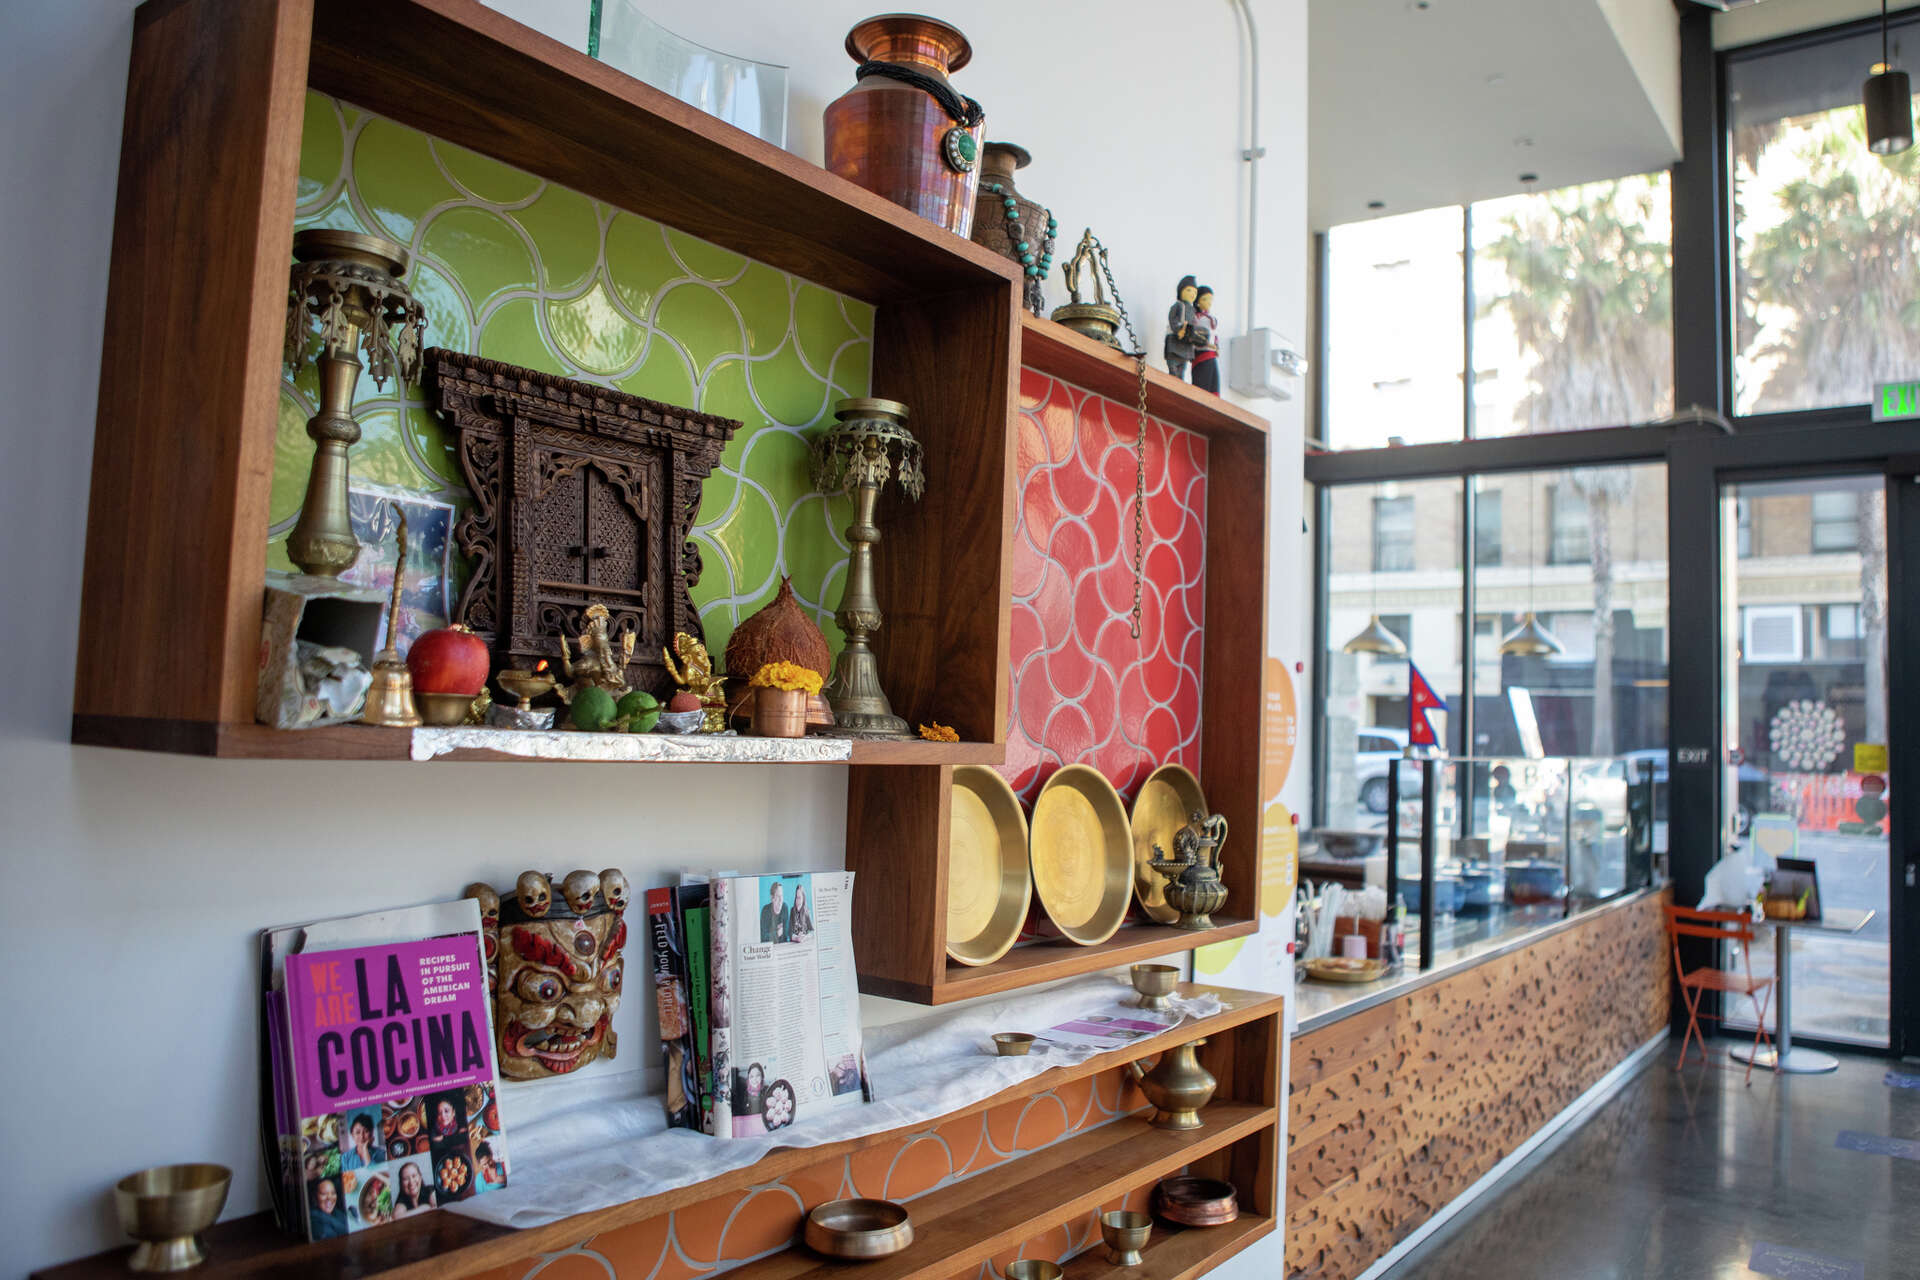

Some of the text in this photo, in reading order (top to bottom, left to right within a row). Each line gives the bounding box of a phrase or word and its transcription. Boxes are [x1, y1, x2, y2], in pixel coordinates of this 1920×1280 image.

[1882, 384, 1920, 417] EXI
[1677, 747, 1709, 763] EXIT
[654, 923, 669, 948] FEED
[419, 954, 456, 966] RECIPES
[421, 962, 470, 976] IN PURSUIT
[309, 961, 343, 994] WE
[354, 954, 412, 1021] LA
[422, 974, 453, 986] OF THE
[423, 982, 470, 995] AMERICAN
[424, 993, 457, 1005] DREAM
[315, 991, 356, 1028] ARE
[317, 1010, 485, 1098] COCINA
